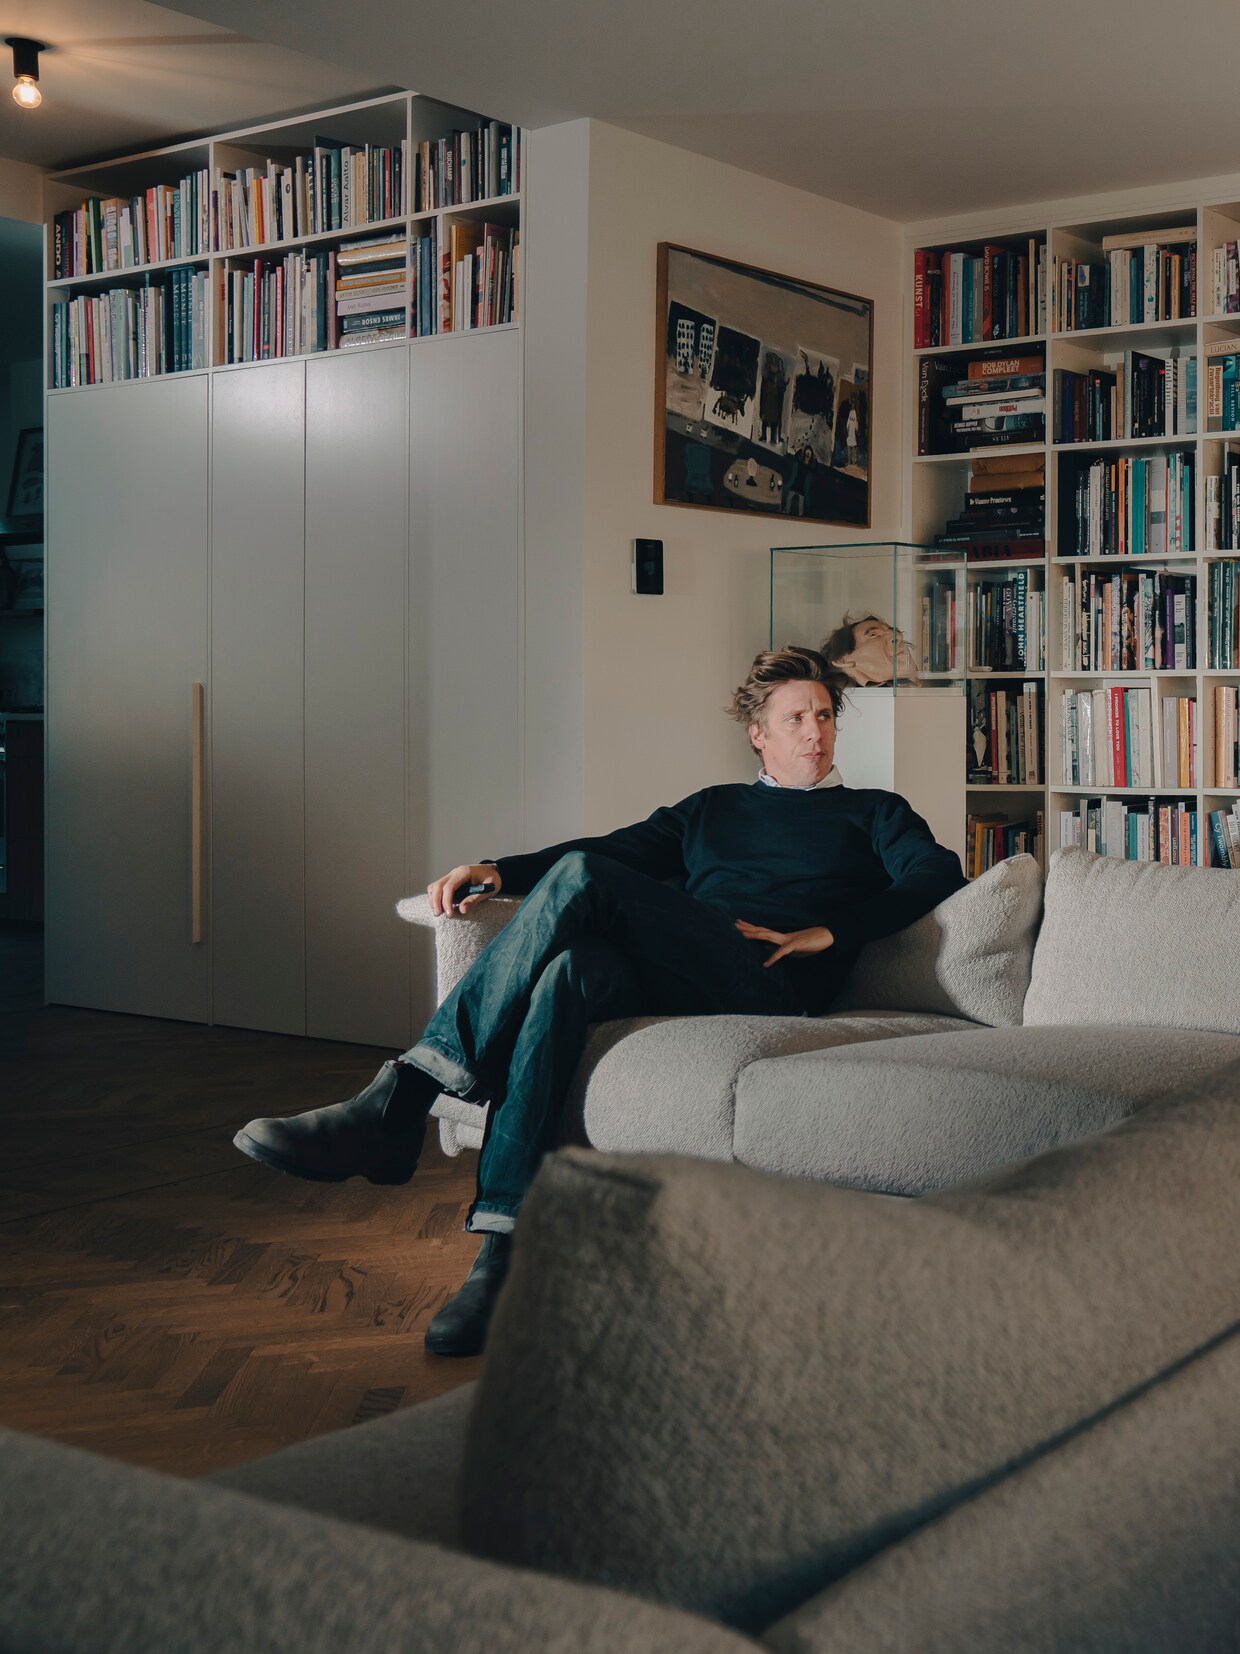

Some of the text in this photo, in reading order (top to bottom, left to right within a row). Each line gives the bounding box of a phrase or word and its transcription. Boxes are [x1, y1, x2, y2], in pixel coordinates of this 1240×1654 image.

[1210, 344, 1238, 354] LUCIAN
[996, 359, 1019, 368] DYLAN
[920, 360, 928, 381] Van
[982, 366, 1019, 375] COMPLEET
[1214, 823, 1228, 867] Cy Twombly
